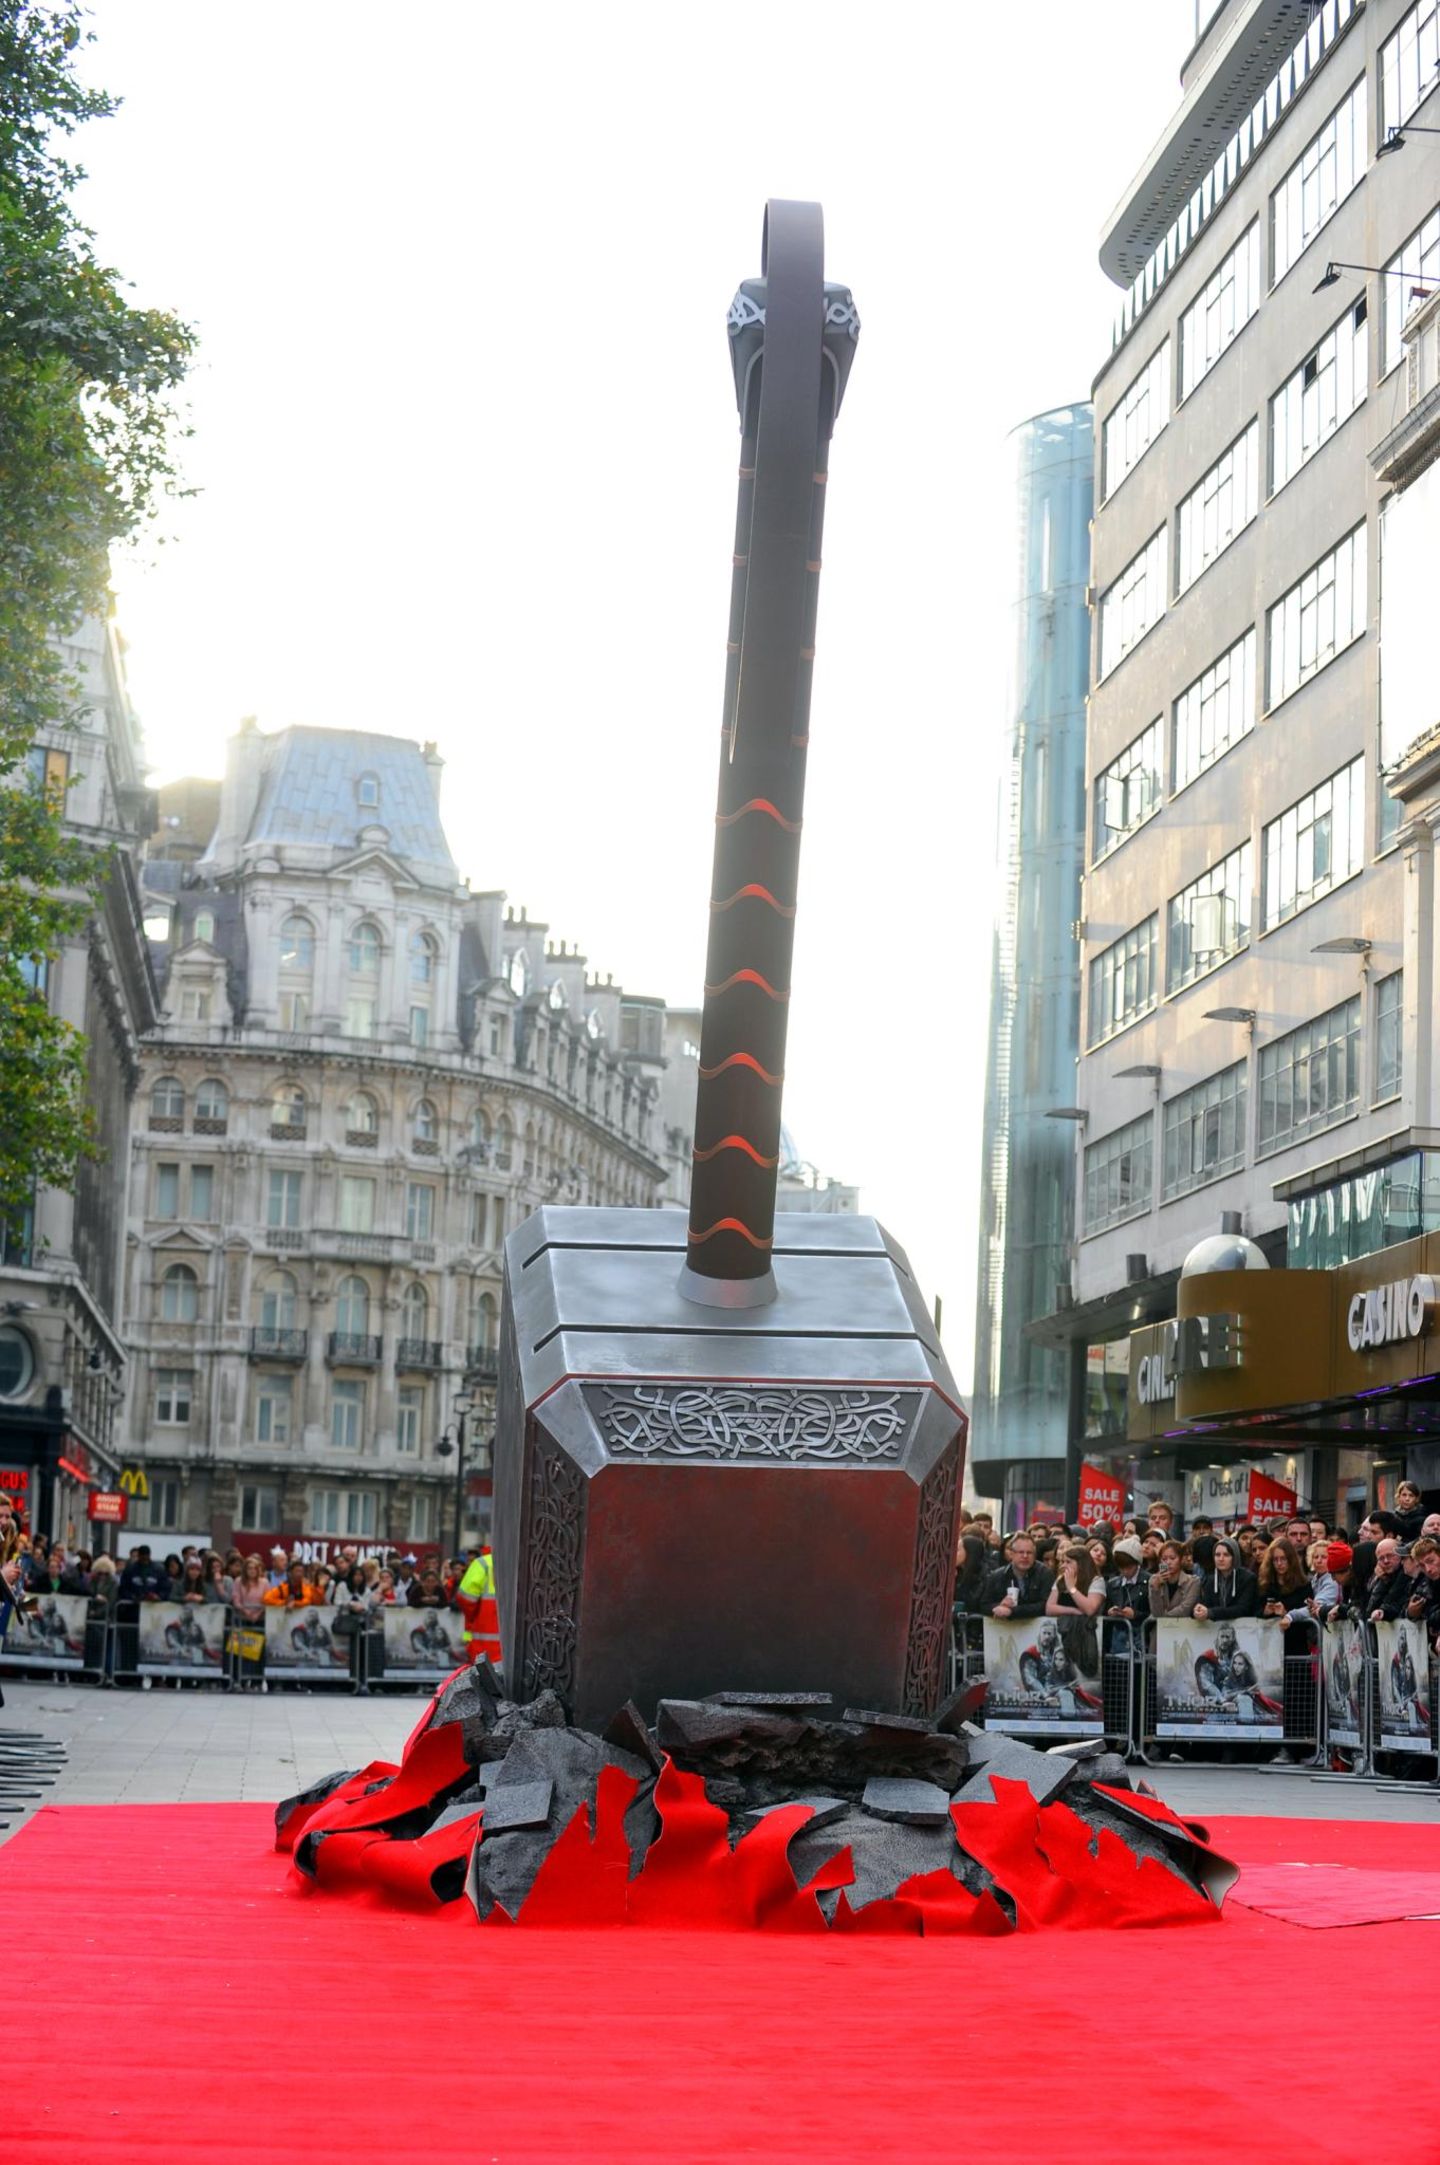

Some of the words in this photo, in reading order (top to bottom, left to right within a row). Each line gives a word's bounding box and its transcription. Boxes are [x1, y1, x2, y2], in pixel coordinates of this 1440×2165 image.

[1348, 1274, 1425, 1352] CASINO
[0, 1471, 29, 1489] GUS
[1084, 1488, 1120, 1502] SALE
[1082, 1503, 1120, 1521] 50%
[1253, 1498, 1292, 1513] SALE
